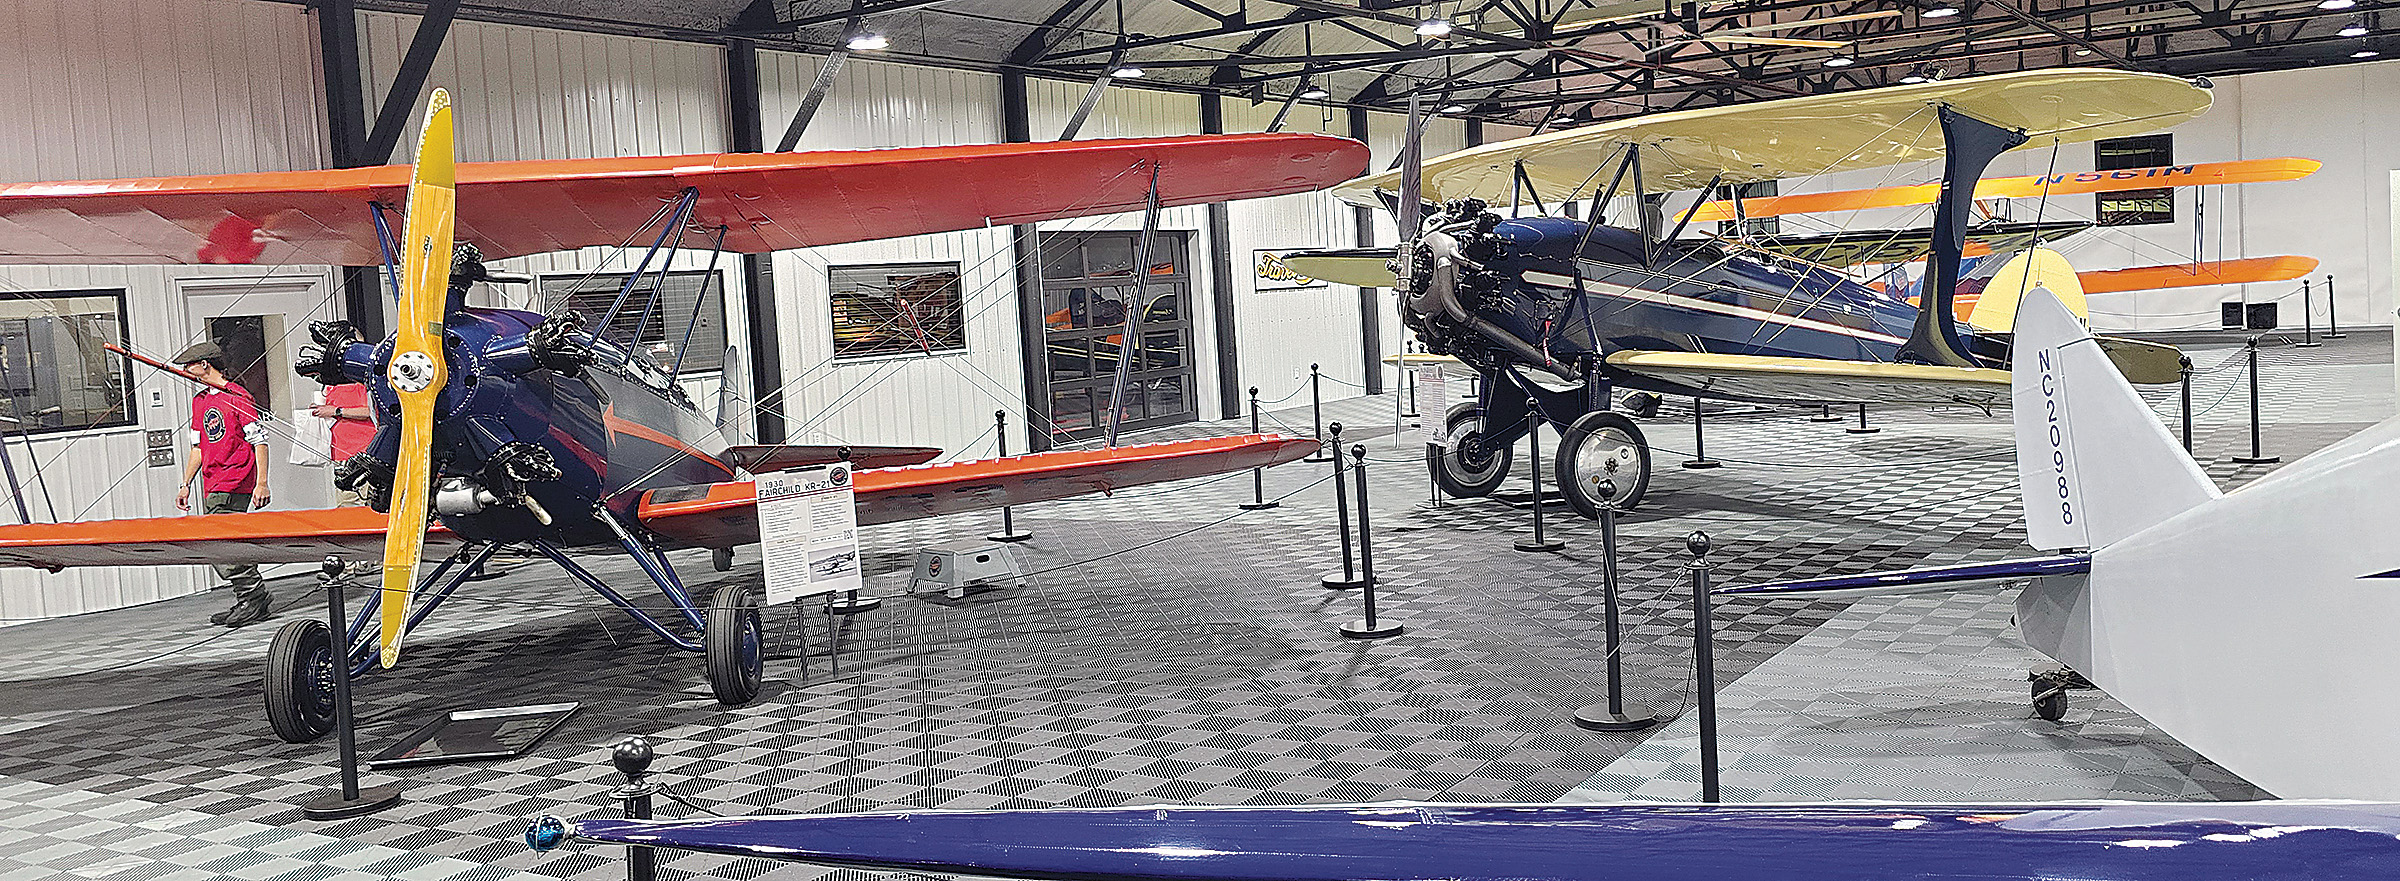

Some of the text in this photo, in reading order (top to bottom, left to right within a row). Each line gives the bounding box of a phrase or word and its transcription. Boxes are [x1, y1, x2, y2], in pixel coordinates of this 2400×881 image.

[2039, 349, 2073, 525] NC20988
[765, 480, 783, 488] 1930
[759, 485, 801, 499] FAIRCHILD
